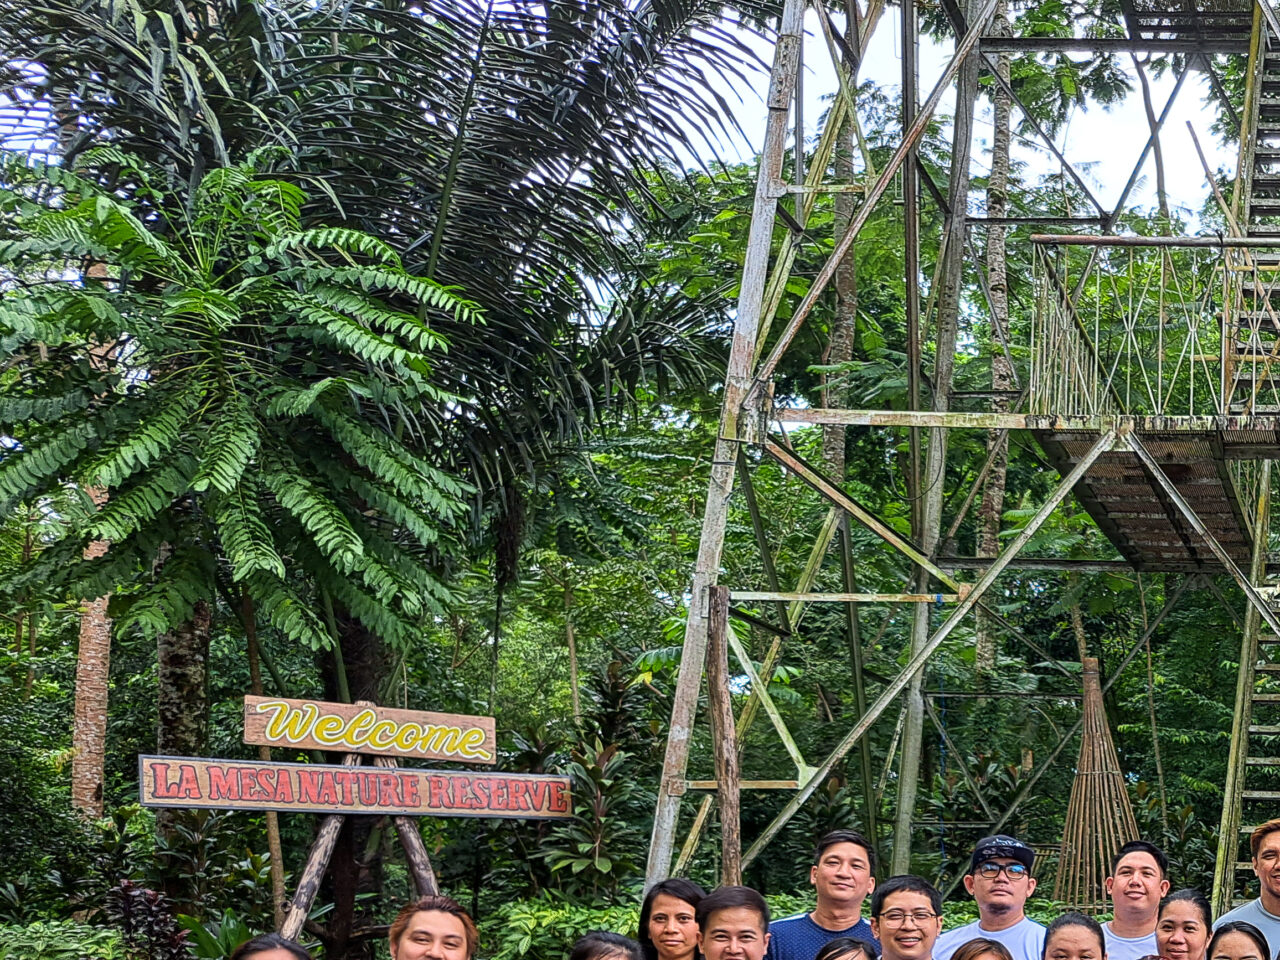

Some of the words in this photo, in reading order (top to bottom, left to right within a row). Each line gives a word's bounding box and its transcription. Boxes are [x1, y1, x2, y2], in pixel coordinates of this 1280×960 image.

[256, 700, 493, 760] Welcome
[149, 762, 200, 800] LA
[206, 765, 292, 803] MESA
[297, 769, 419, 808] NATURE
[427, 775, 568, 812] RESERVE
